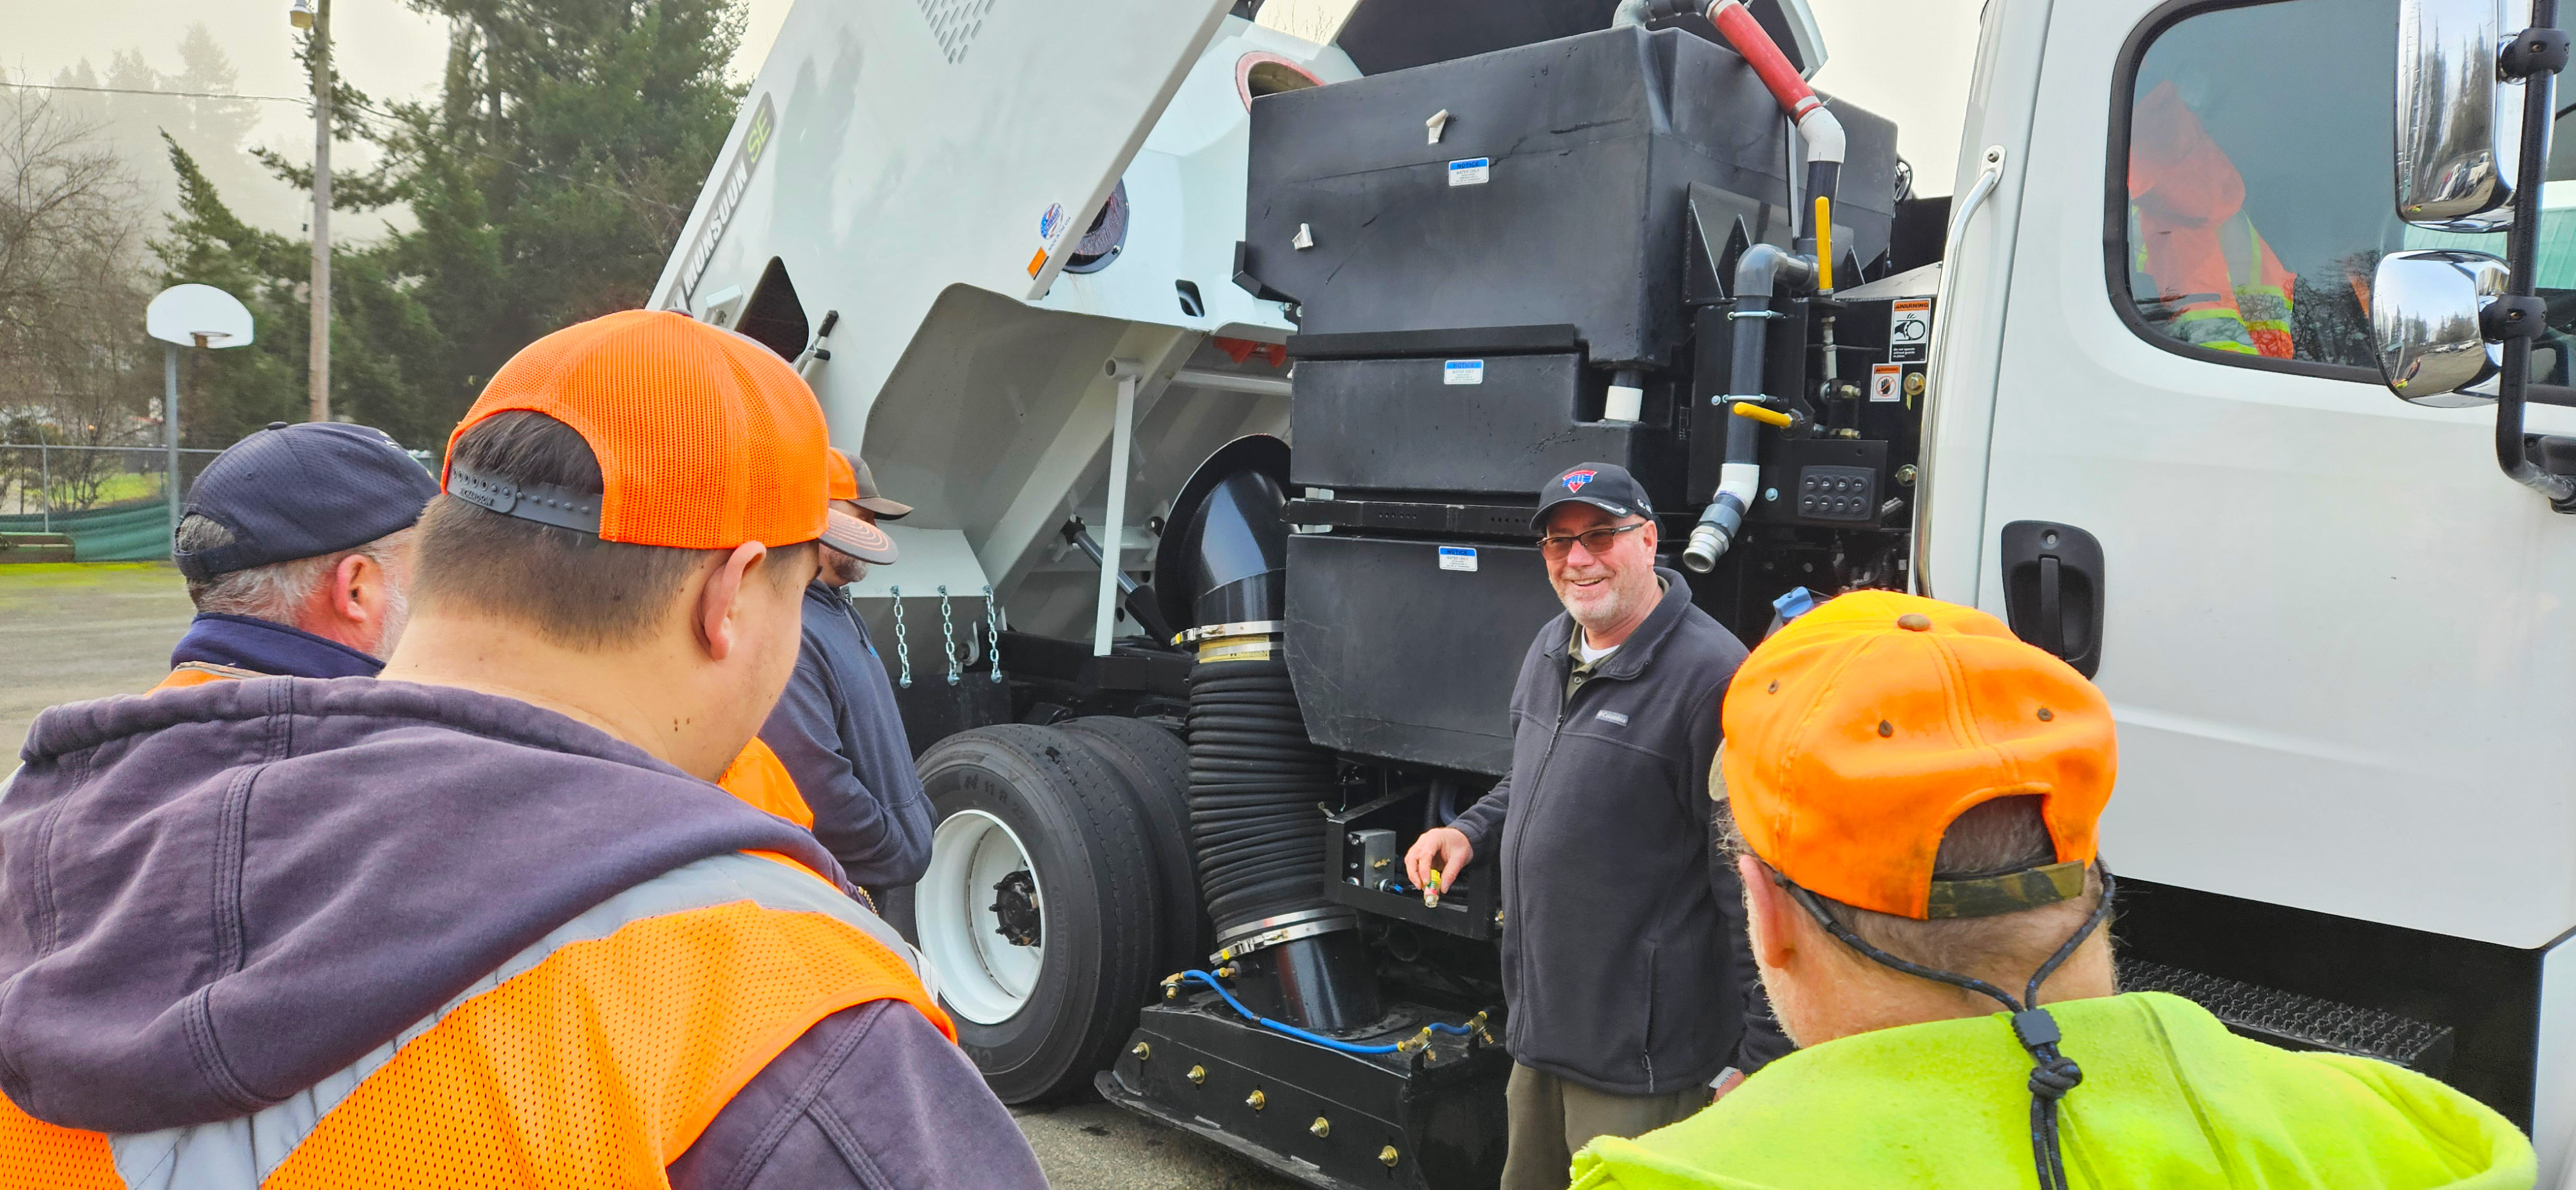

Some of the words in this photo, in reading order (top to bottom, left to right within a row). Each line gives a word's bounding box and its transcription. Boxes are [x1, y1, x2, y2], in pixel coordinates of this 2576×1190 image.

[683, 156, 747, 296] MONSOON
[747, 108, 770, 163] SE
[1602, 712, 1626, 723] Columbia
